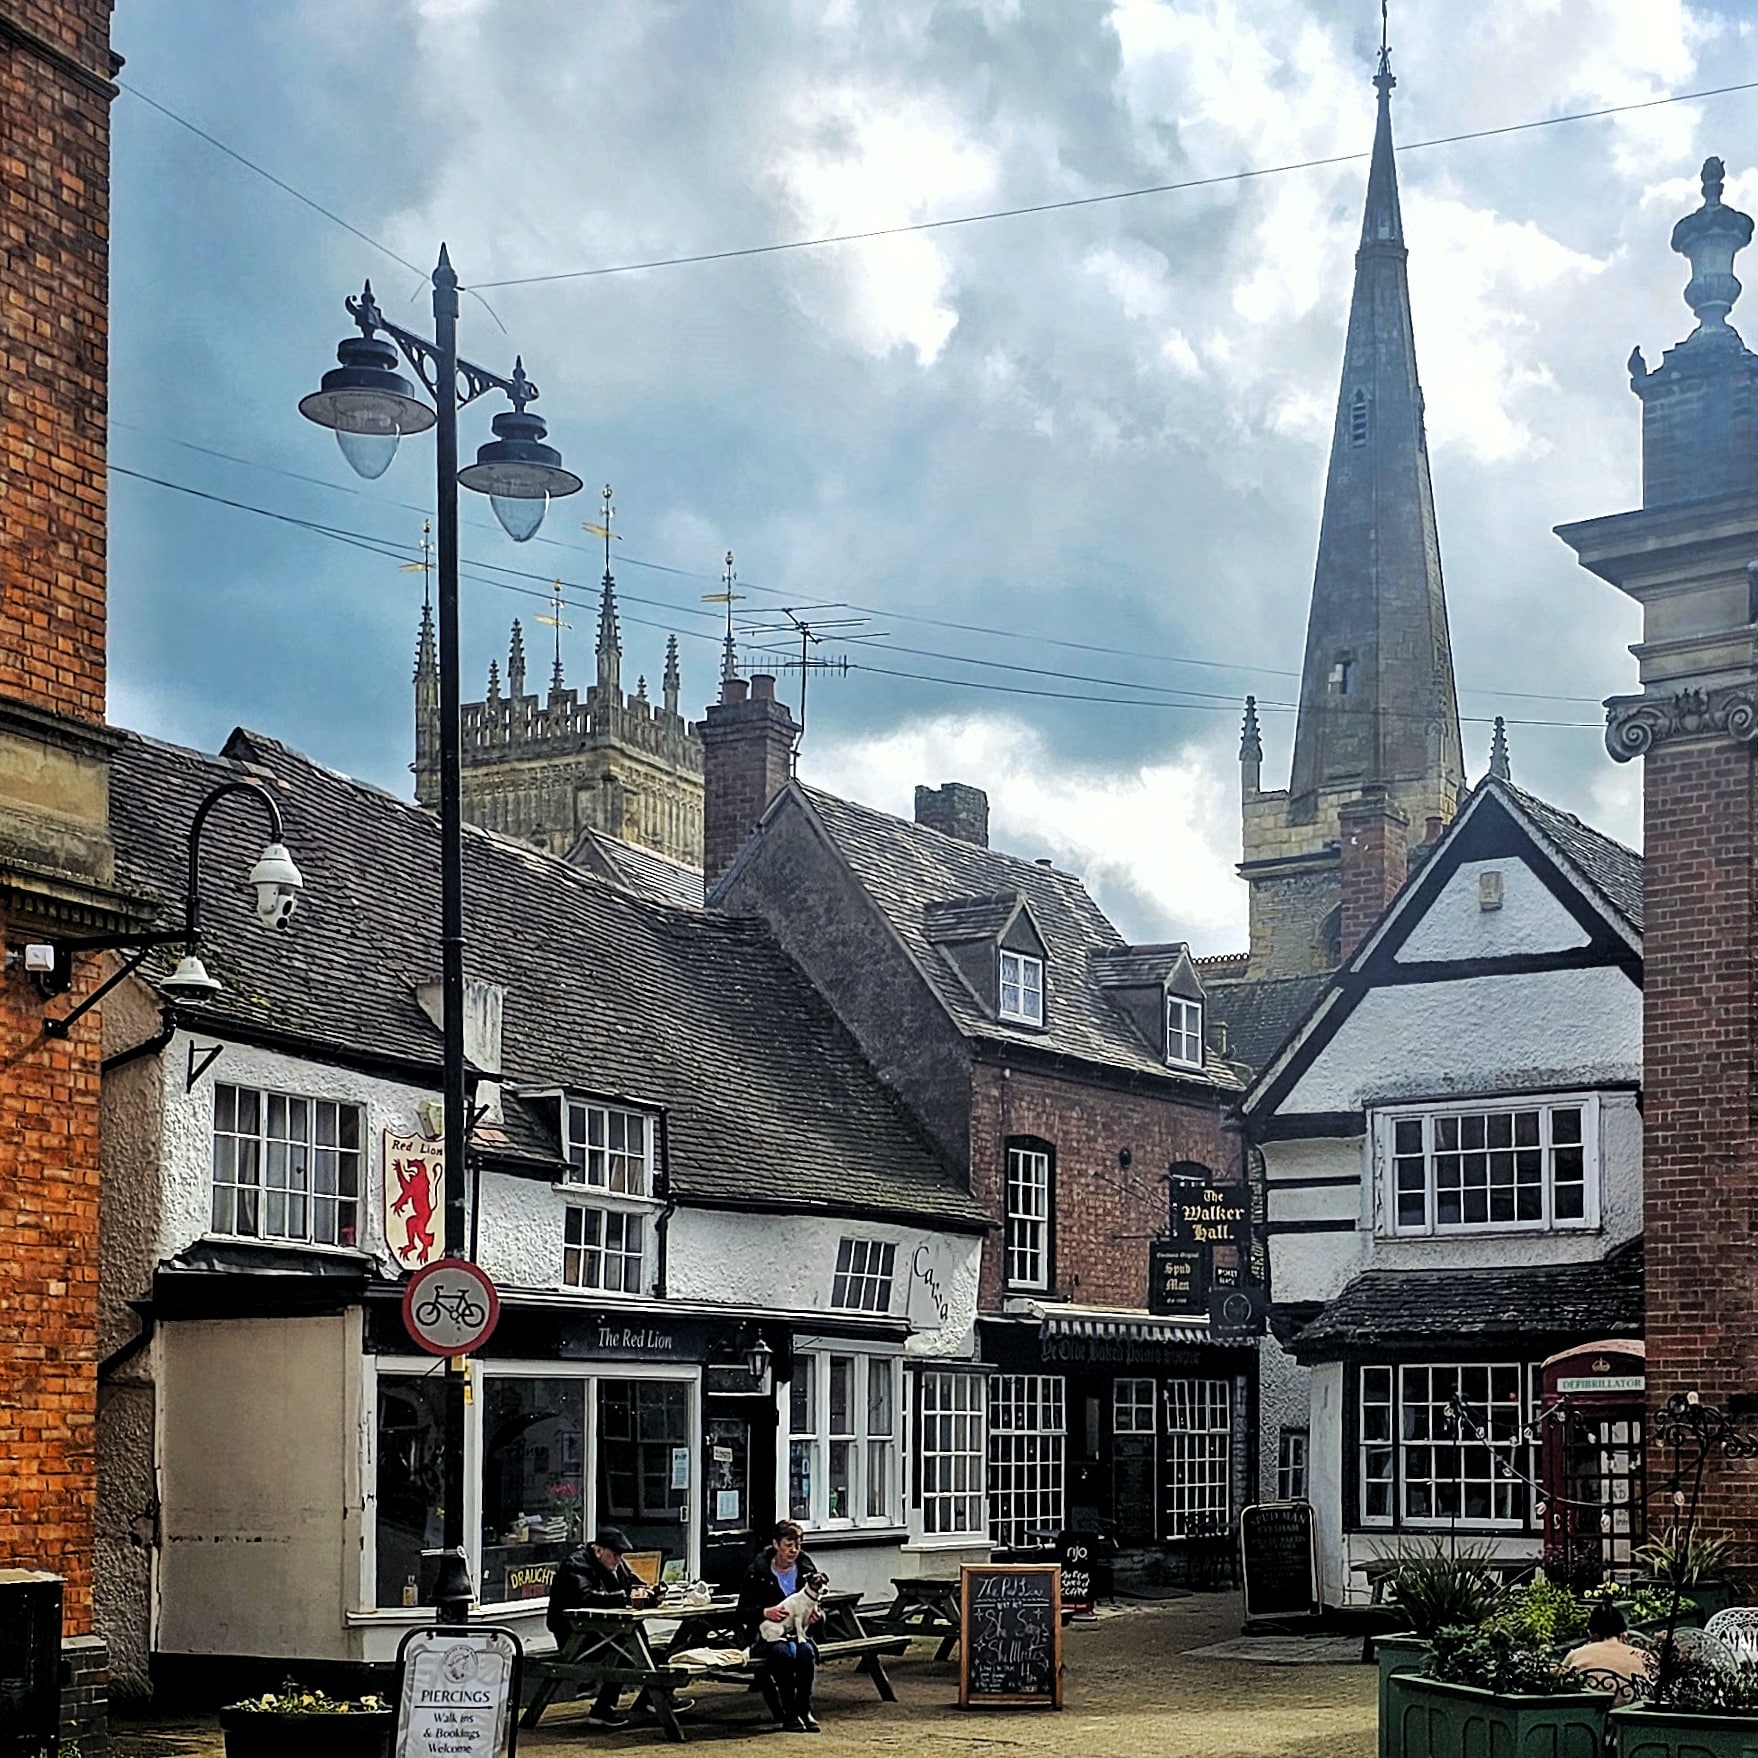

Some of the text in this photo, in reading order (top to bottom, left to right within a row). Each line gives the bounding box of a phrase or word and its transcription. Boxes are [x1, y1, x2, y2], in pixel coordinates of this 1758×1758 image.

[392, 1140, 443, 1156] Red Lion
[1203, 1189, 1224, 1203] The
[1182, 1205, 1245, 1221] Walker
[1164, 1262, 1191, 1277] Spud
[1166, 1278, 1190, 1291] Man
[598, 1327, 672, 1350] The Red Lion
[1562, 1379, 1642, 1390] DEFIBRILLATOR
[510, 1567, 557, 1589] DRAUGHT
[977, 1577, 999, 1598] The
[420, 1689, 491, 1703] PIERCINGS
[434, 1712, 474, 1723] Walk ins
[423, 1728, 480, 1740] & Bookings
[429, 1743, 473, 1754] Welcome
